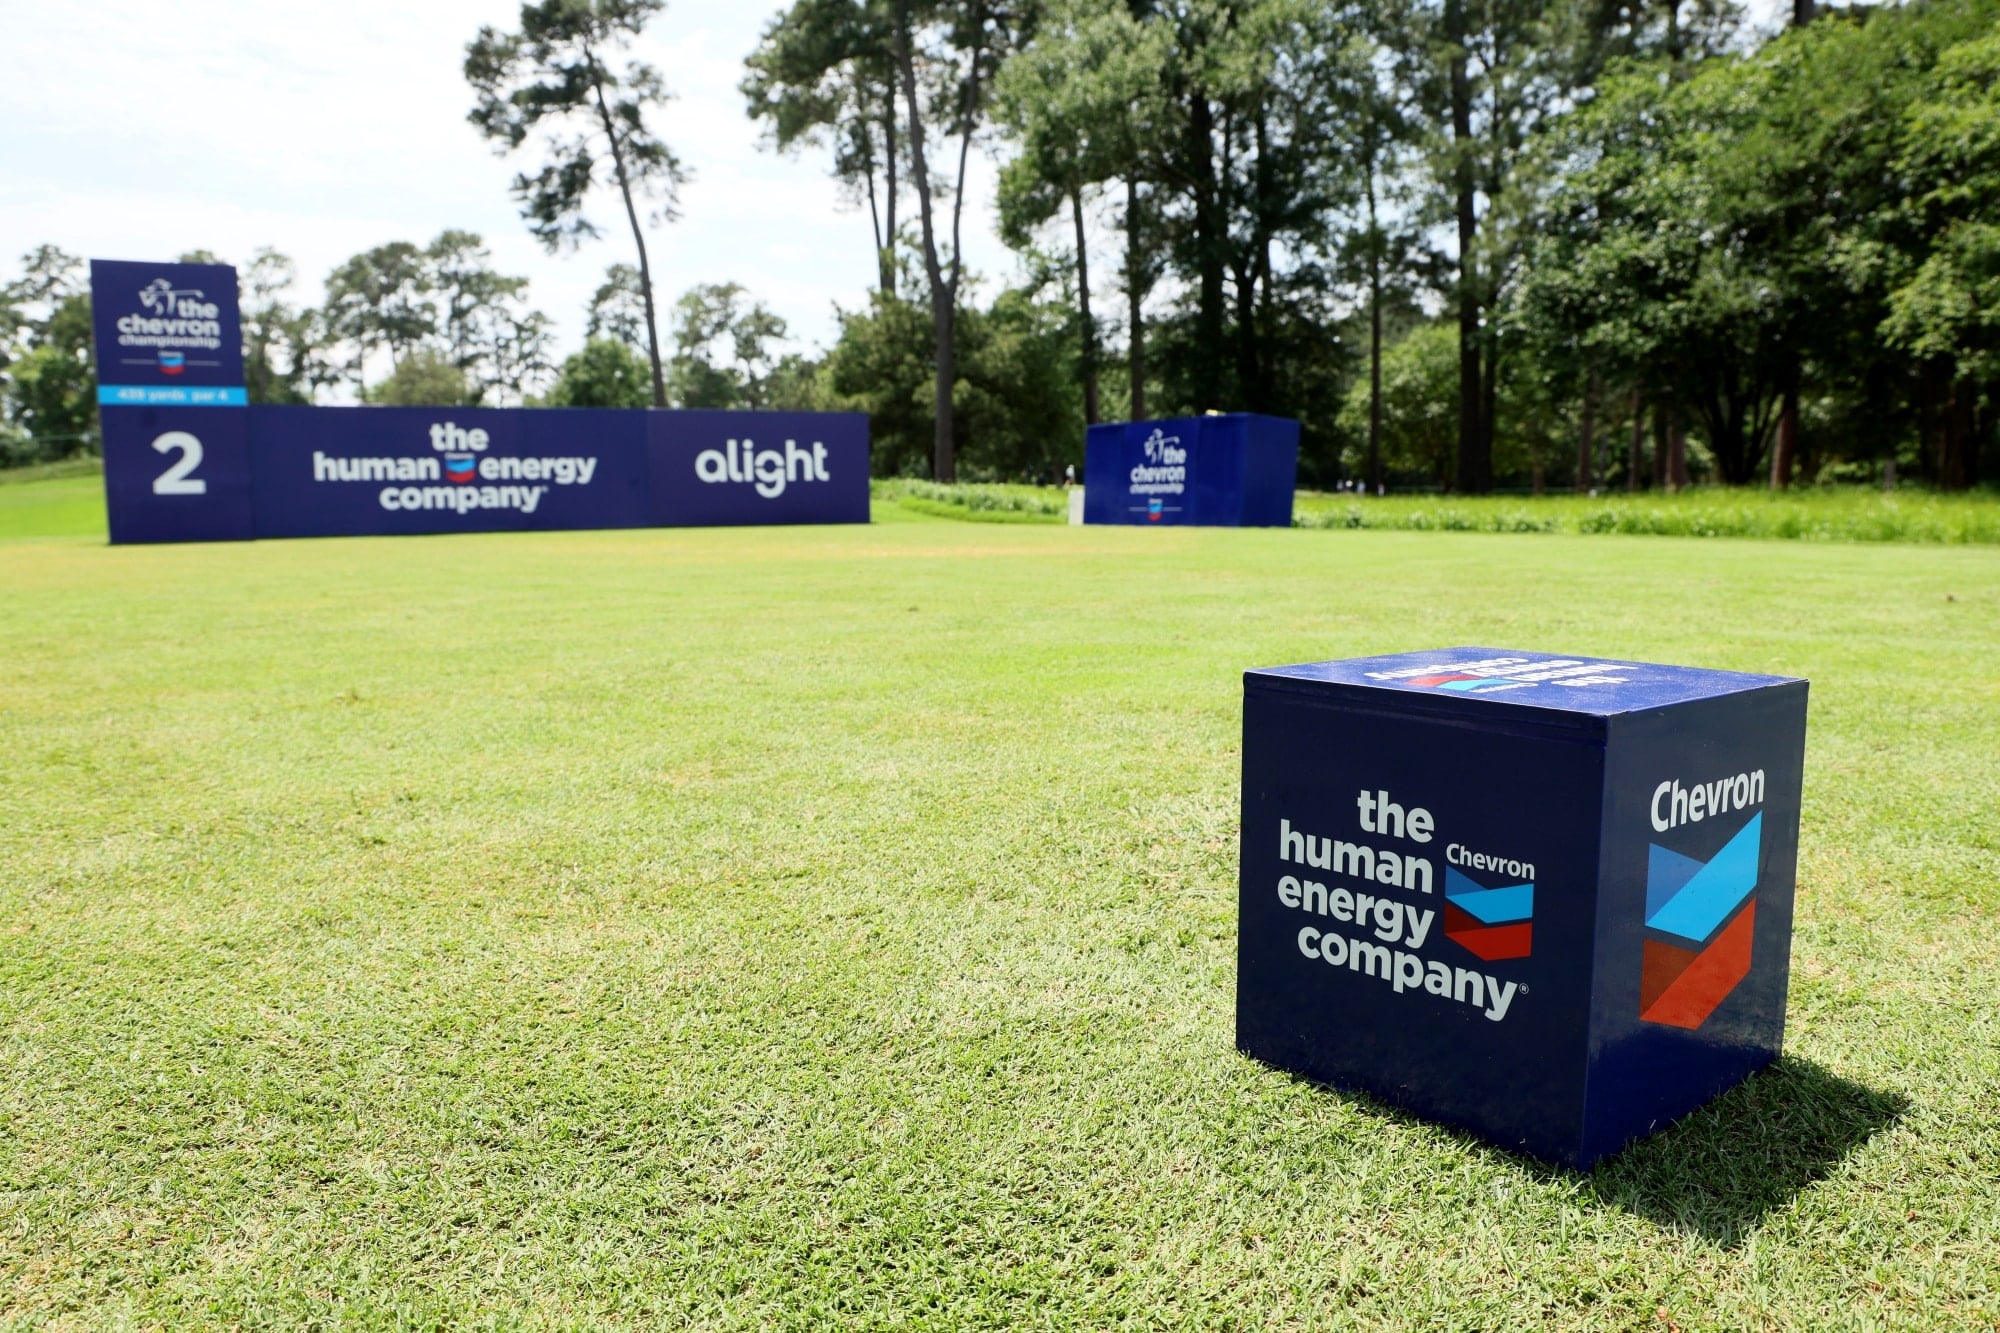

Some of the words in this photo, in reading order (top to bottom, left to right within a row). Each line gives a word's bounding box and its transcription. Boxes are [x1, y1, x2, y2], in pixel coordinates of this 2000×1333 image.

[117, 313, 221, 337] chevron
[178, 298, 218, 320] the
[429, 421, 489, 451] the
[151, 431, 206, 495] 2
[313, 451, 440, 481] human
[479, 457, 597, 484] energy
[695, 439, 830, 499] alight
[1130, 463, 1186, 483] chevron
[1357, 790, 1435, 843] the
[1651, 769, 1765, 833] Chevron
[1280, 819, 1433, 894] human
[1446, 843, 1535, 880] Chevron
[1277, 875, 1435, 949] energy
